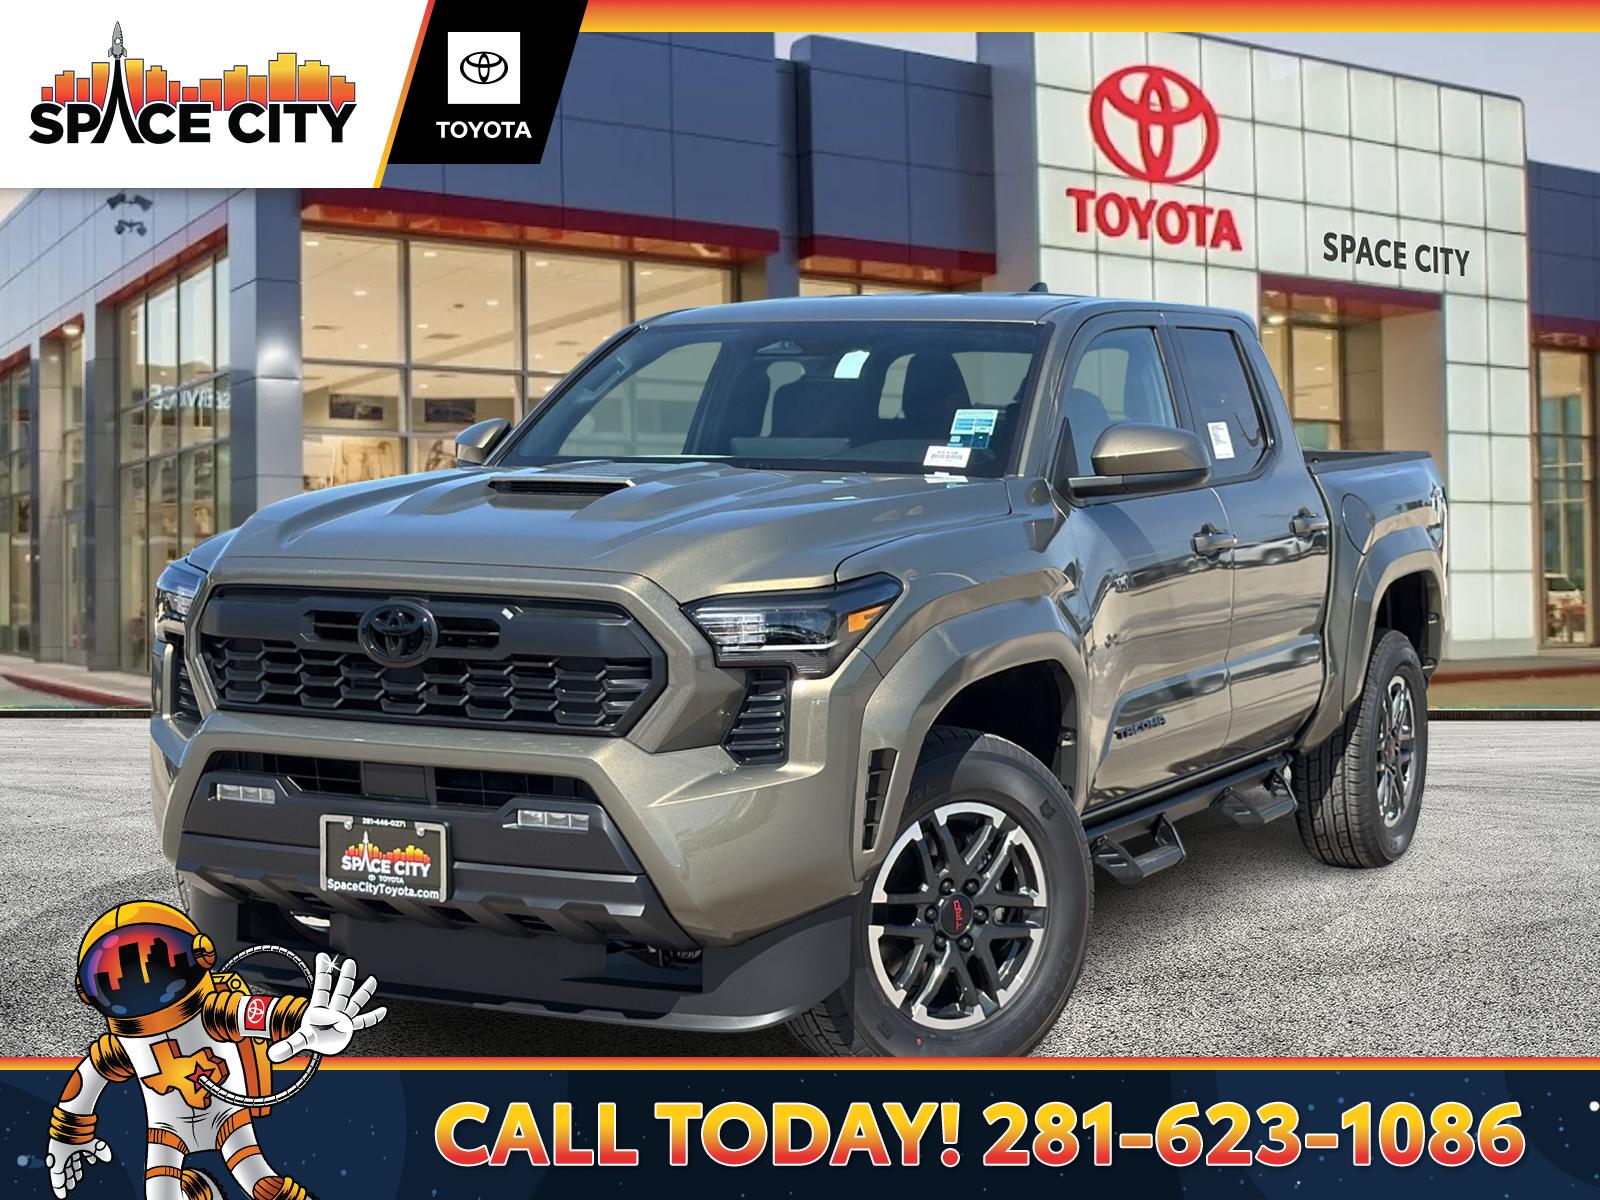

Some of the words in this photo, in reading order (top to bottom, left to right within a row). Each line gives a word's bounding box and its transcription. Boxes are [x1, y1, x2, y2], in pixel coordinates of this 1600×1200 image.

[1065, 188, 1242, 251] TOYOTA
[1323, 231, 1407, 270] SPACE
[1415, 243, 1470, 277] CITY
[341, 854, 391, 873] SPACE
[394, 860, 431, 877] CITY
[327, 878, 439, 900] SpaceCityToyota.com
[378, 875, 404, 884] TOYOTA
